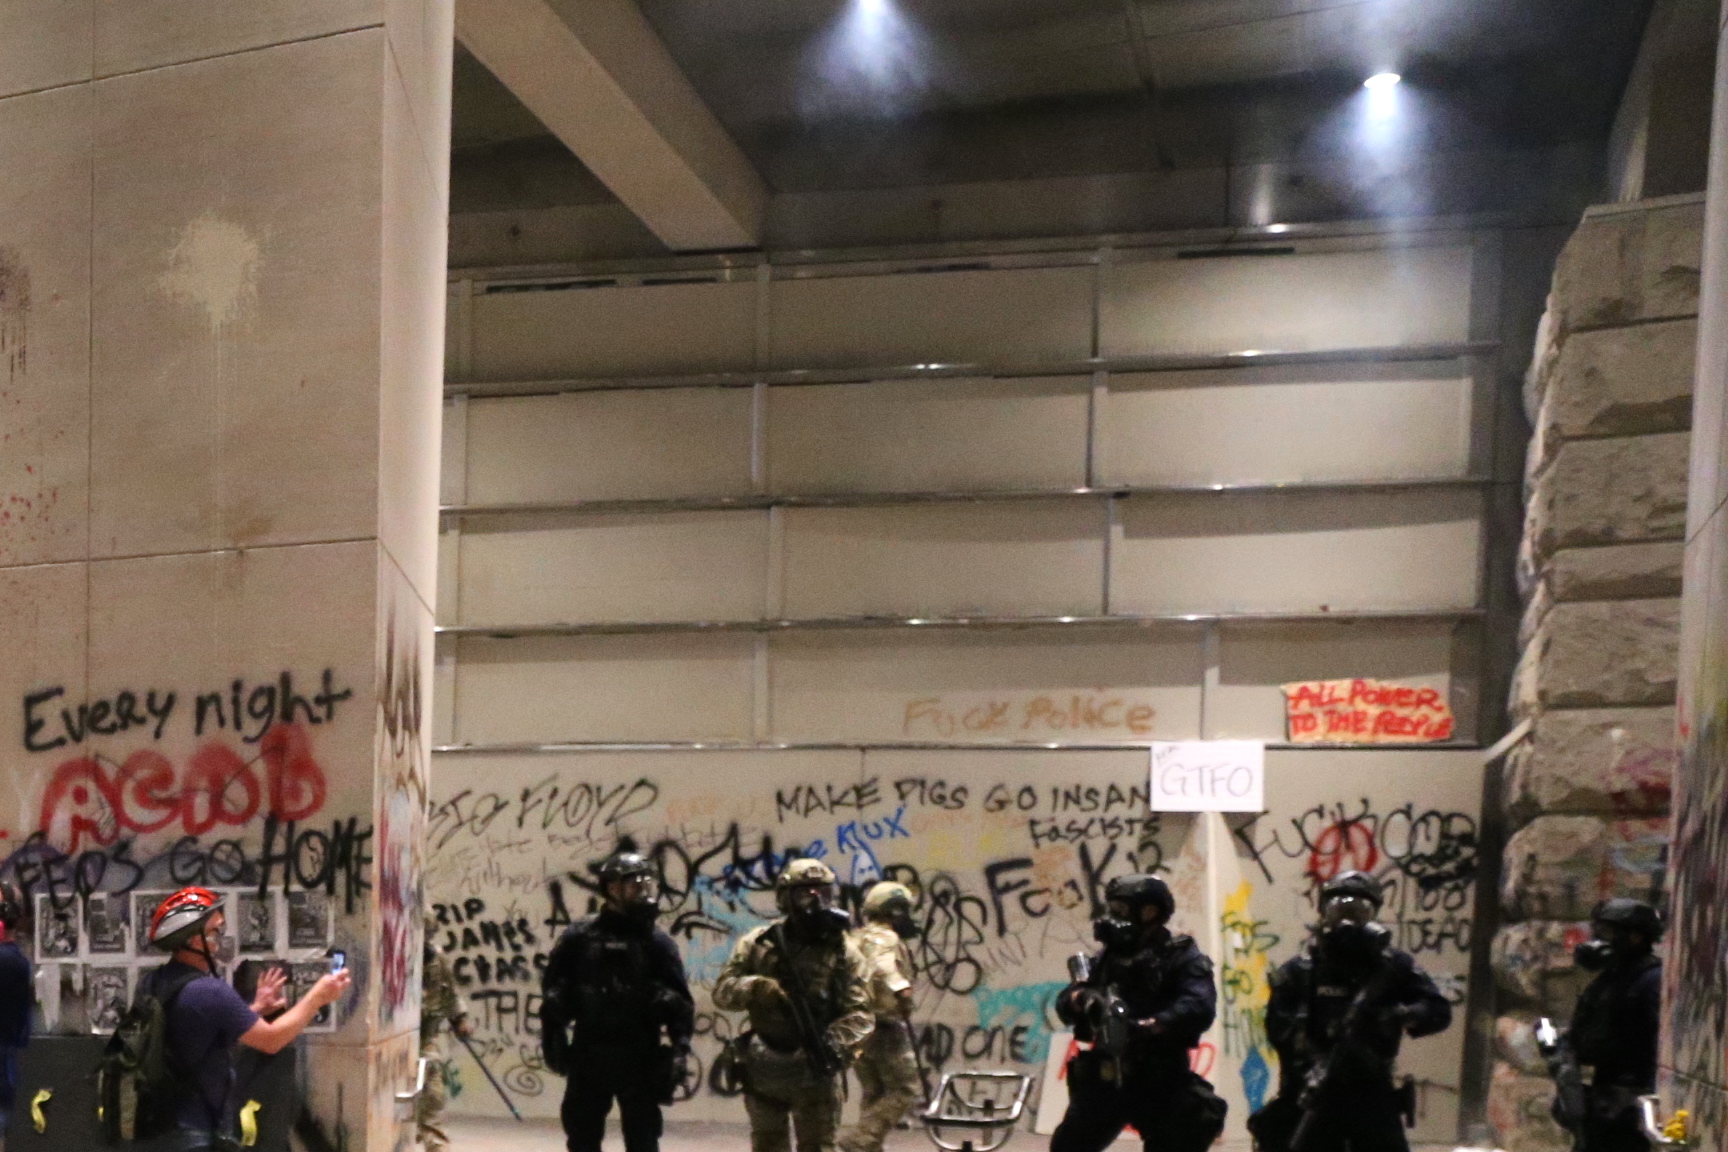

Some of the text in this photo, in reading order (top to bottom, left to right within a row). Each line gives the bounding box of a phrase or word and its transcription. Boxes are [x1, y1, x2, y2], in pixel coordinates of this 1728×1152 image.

[22, 668, 352, 752] Every night
[1288, 683, 1343, 710] ALL
[1290, 712, 1318, 736] TO
[1160, 762, 1253, 797] GTFO
[776, 777, 1152, 823] MAKE PIGS GO INSAN
